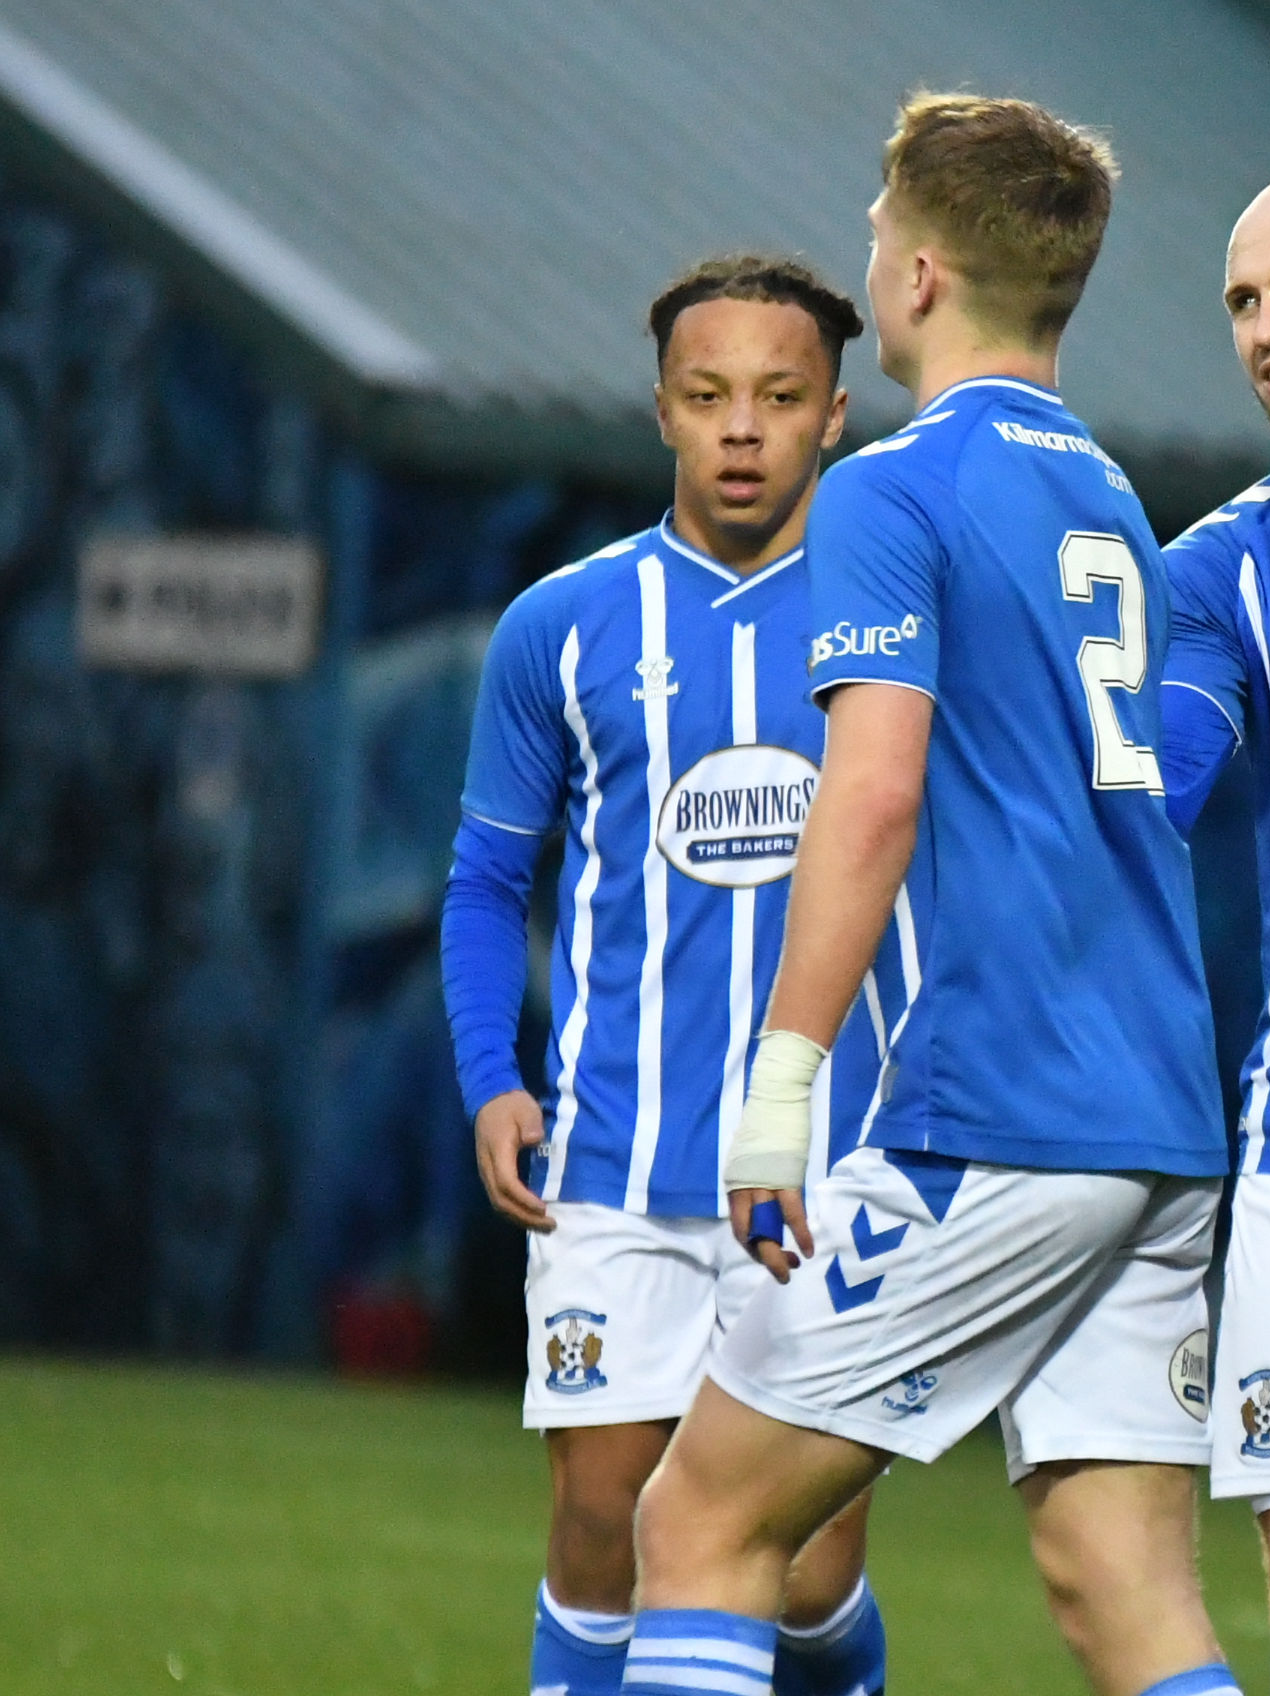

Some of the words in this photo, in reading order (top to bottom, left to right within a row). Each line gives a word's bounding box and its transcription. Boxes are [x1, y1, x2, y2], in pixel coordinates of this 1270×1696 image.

[1058, 530, 1166, 796] 2
[676, 777, 815, 833] BROWNINGS
[696, 843, 726, 856] THE
[731, 838, 793, 853] BAKERS
